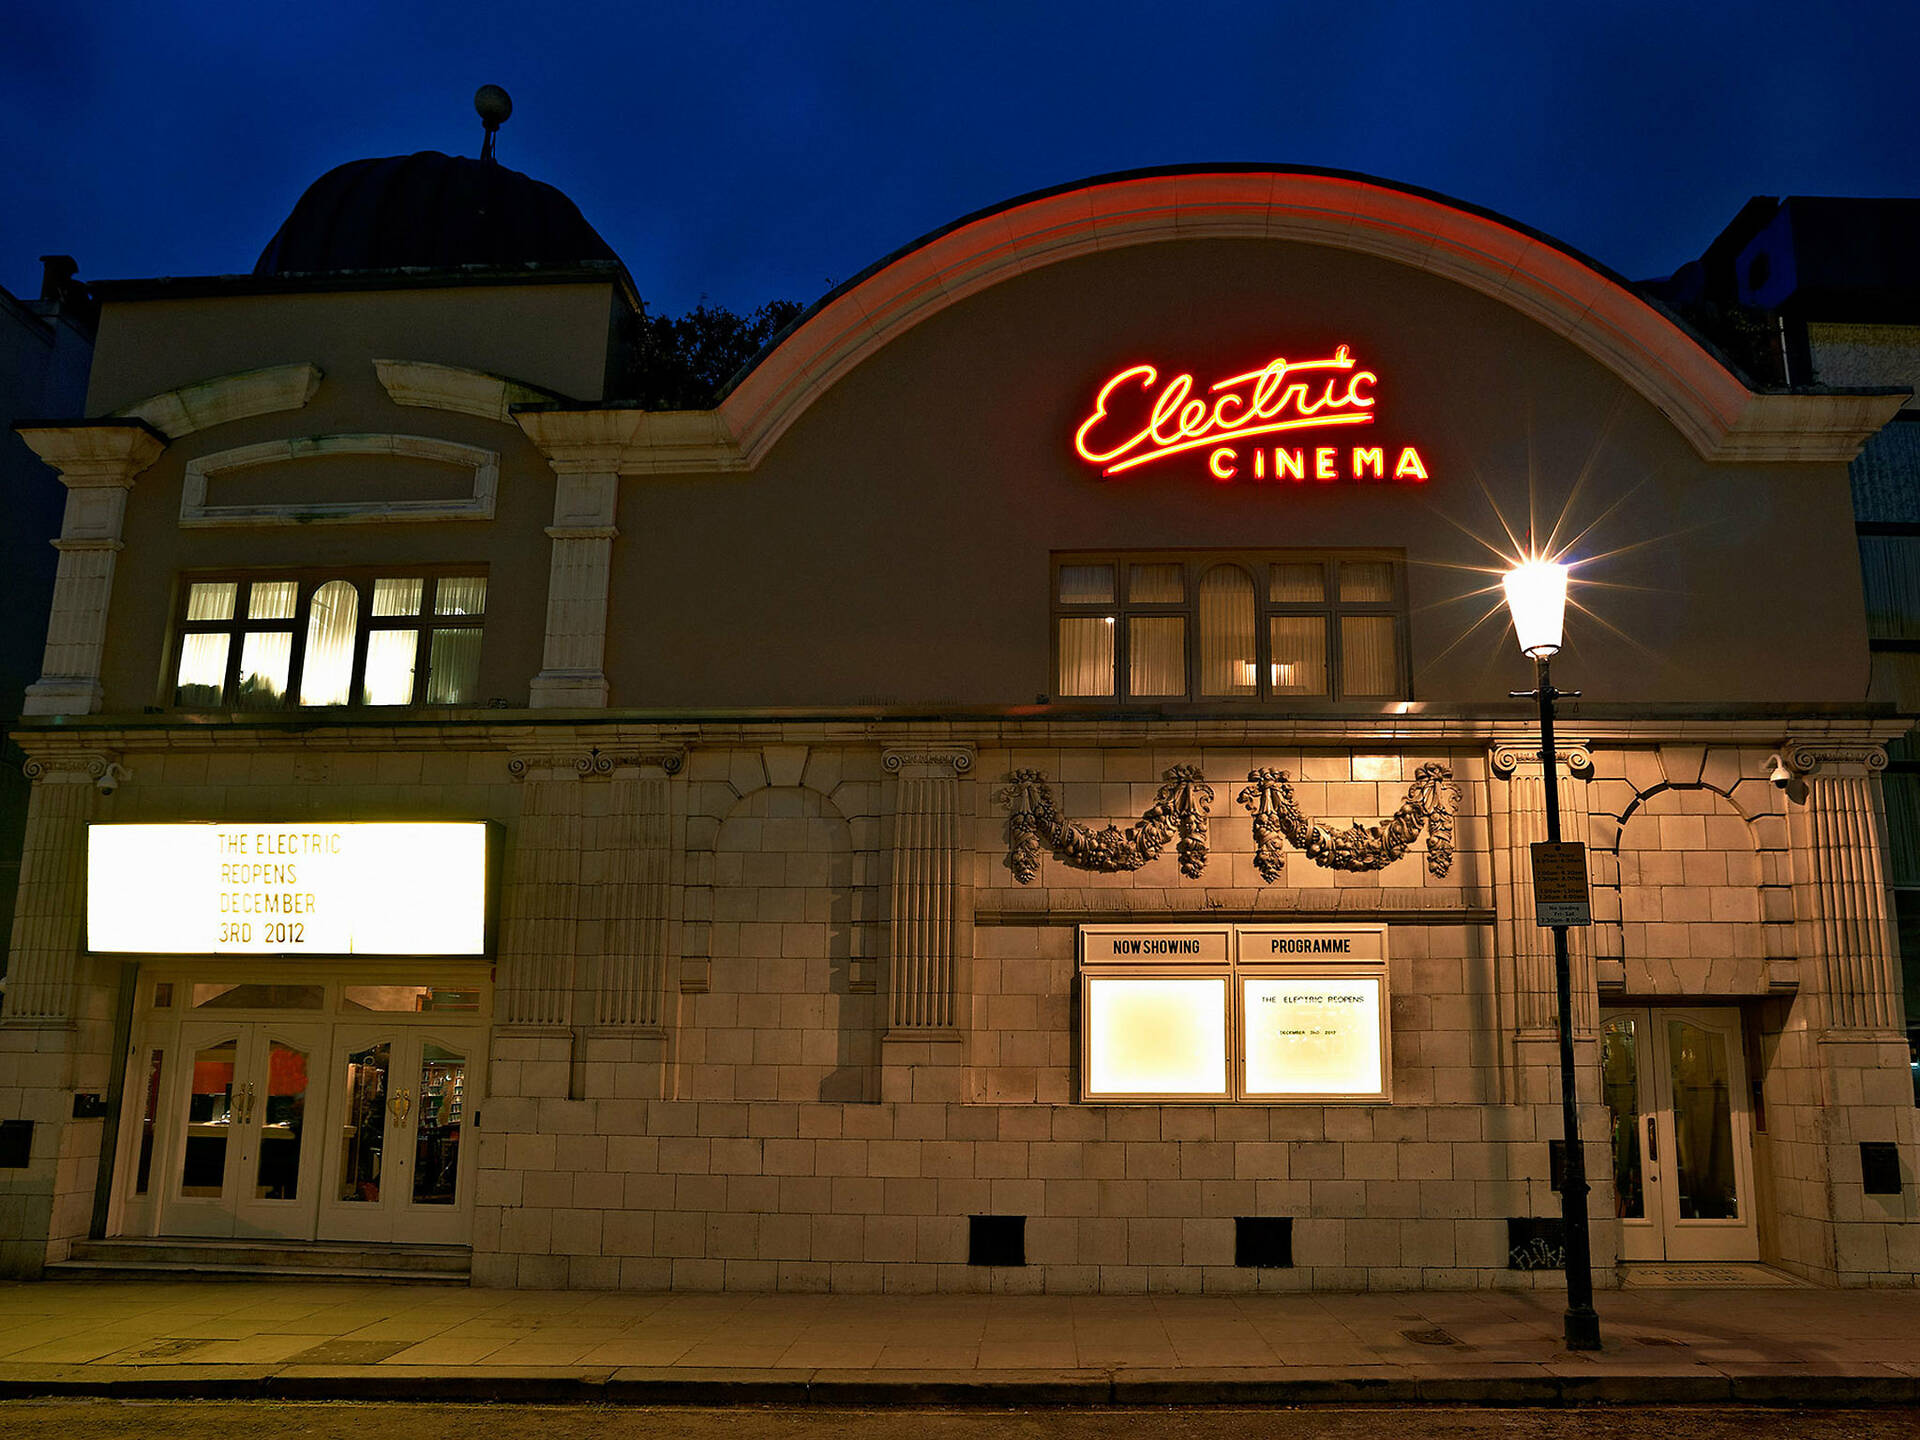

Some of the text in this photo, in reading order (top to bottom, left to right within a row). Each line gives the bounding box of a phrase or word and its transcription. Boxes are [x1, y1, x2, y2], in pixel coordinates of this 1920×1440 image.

[1076, 345, 1378, 463] Electric
[1208, 447, 1429, 480] CINEMA
[217, 833, 342, 855] THE ELECTRIC
[221, 863, 298, 885] REOPENS
[220, 893, 316, 914] DECEMBER
[218, 922, 305, 943] 3RD 2012
[1113, 939, 1200, 954] NOW SHOWING
[1271, 938, 1351, 954] PROGRAMME
